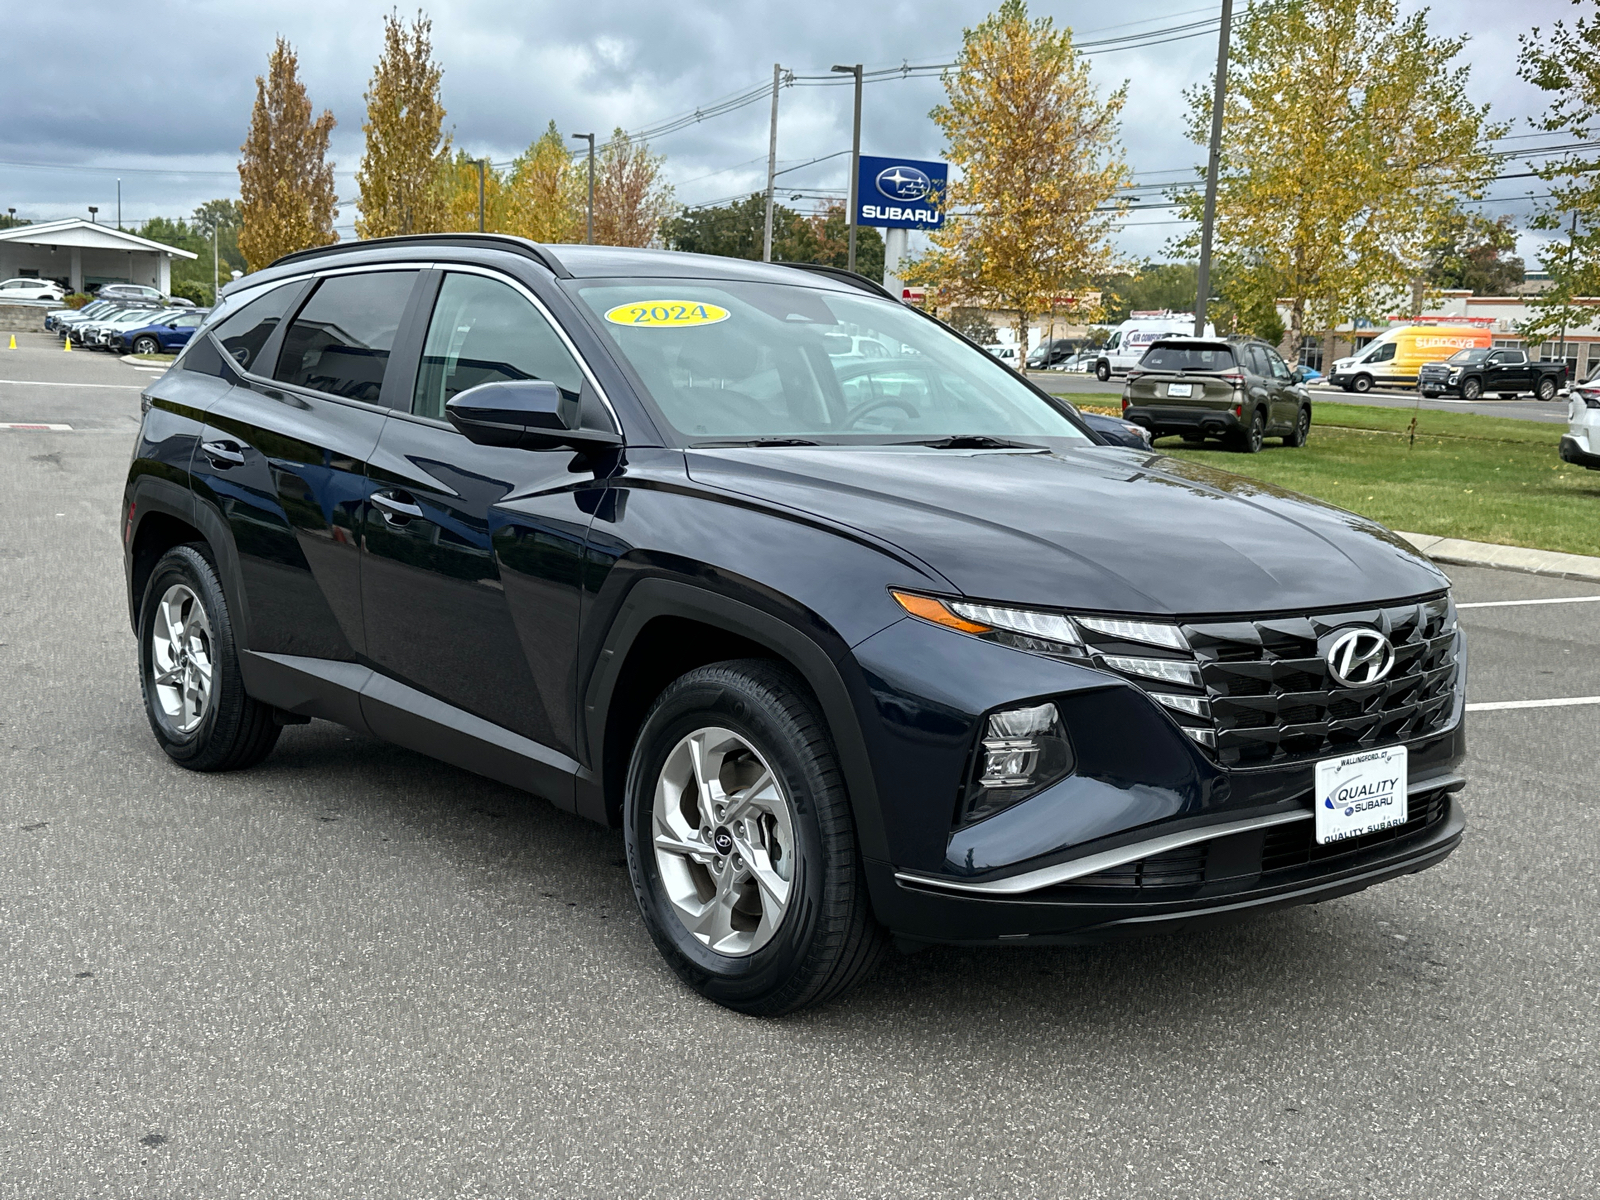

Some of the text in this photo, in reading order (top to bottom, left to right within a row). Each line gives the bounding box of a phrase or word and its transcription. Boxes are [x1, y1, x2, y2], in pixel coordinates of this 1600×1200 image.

[862, 205, 939, 223] SUBARU
[630, 304, 712, 323] 2024
[1132, 333, 1141, 342] AIR
[1415, 337, 1474, 350] sunnova
[1338, 777, 1399, 801] QUALITY
[1354, 796, 1393, 813] SUBARU
[1324, 817, 1405, 844] QUALITY SUBARU
